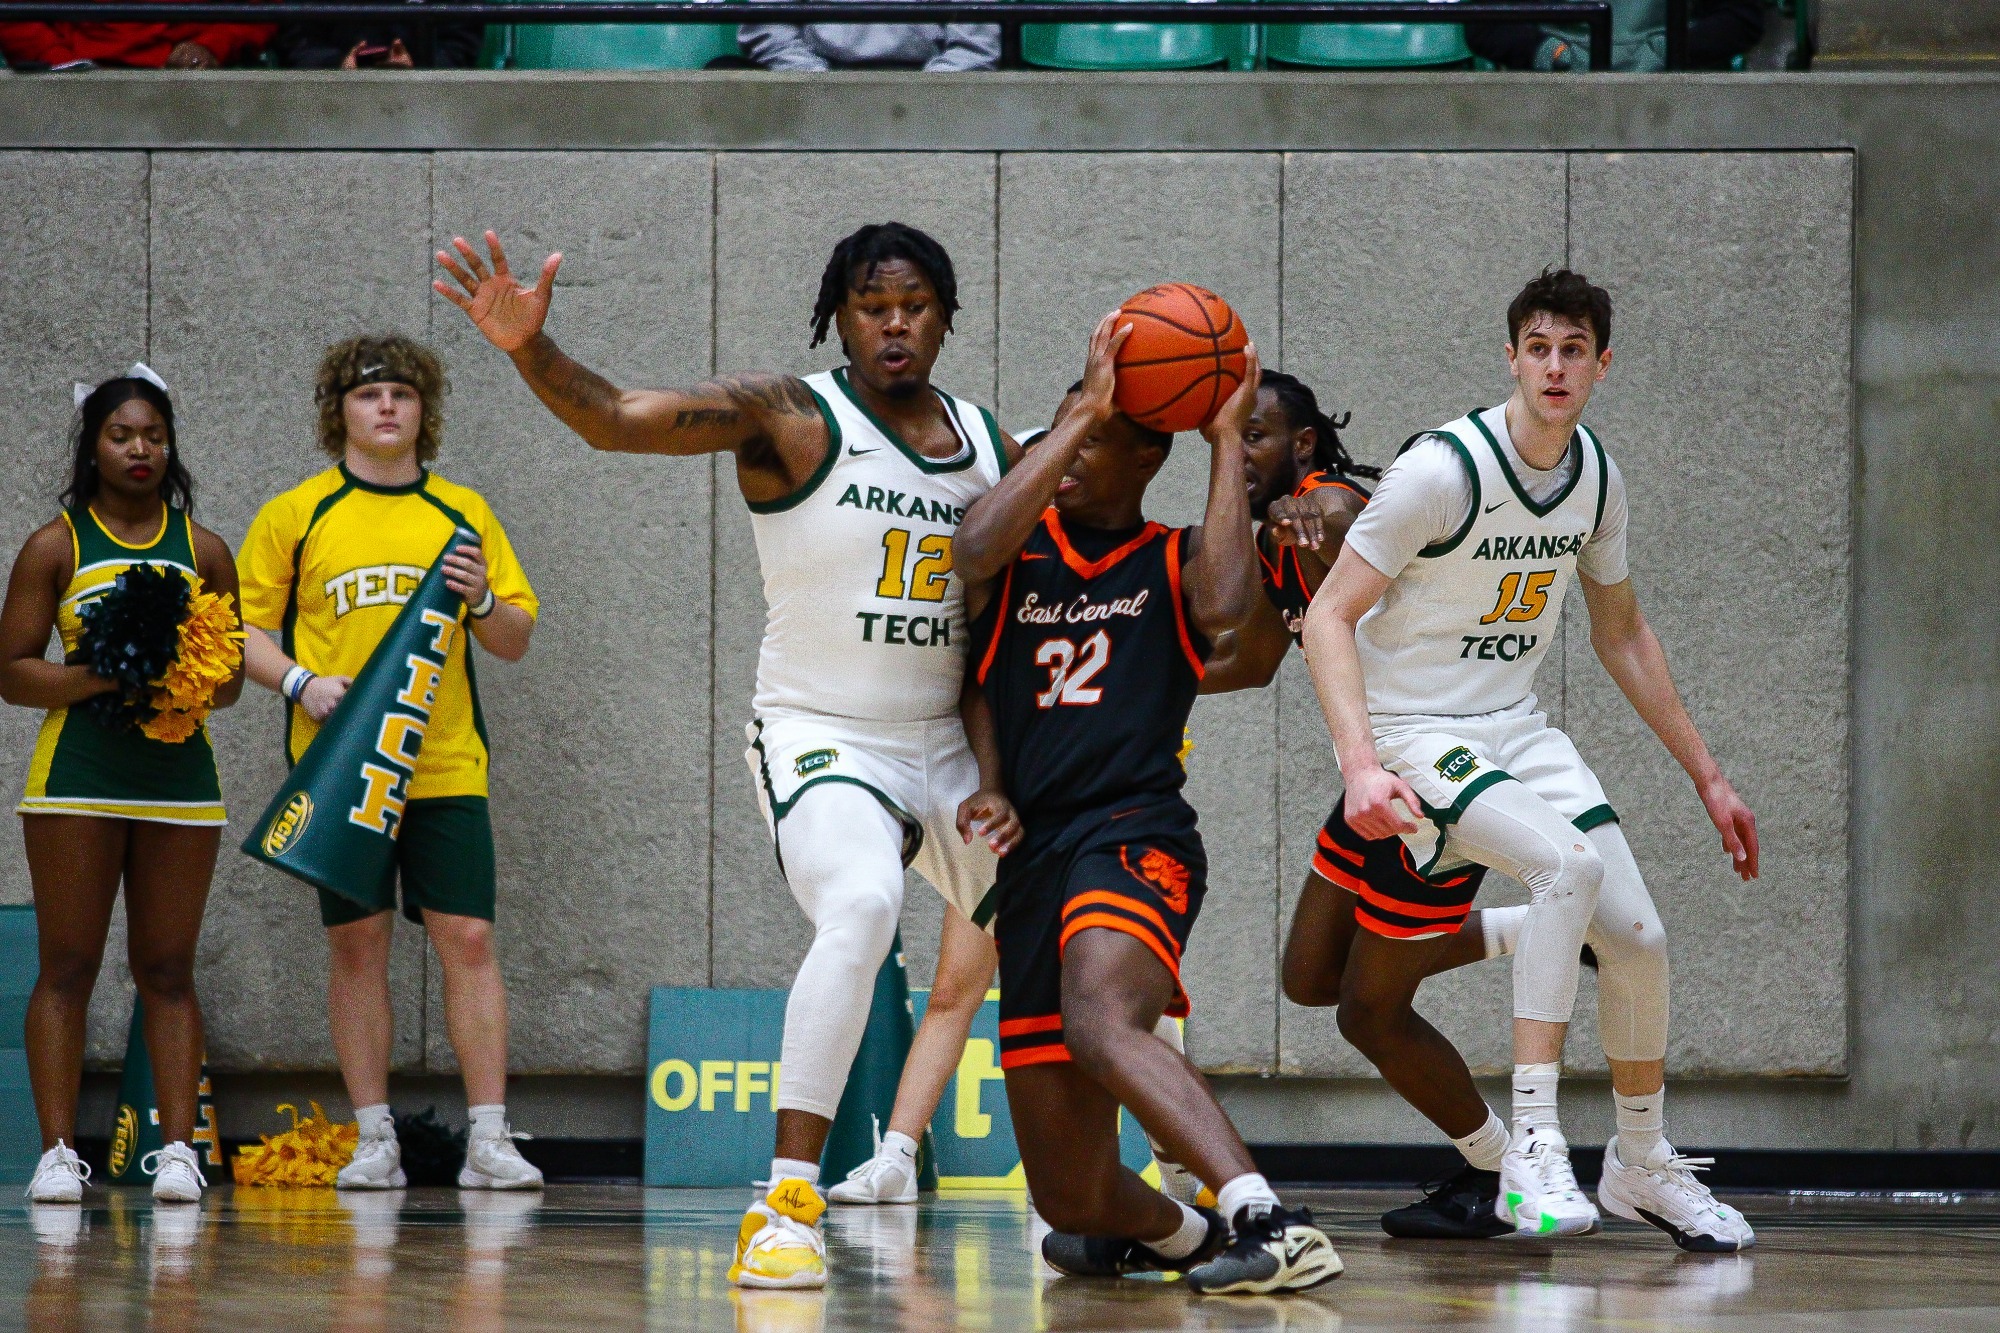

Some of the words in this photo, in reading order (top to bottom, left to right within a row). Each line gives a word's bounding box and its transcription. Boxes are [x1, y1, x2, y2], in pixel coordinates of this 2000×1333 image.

[324, 564, 429, 620] TEC
[875, 528, 954, 603] 12
[1017, 592, 1063, 623] East
[1479, 569, 1557, 625] 15
[856, 612, 951, 647] TECH
[1460, 633, 1537, 662] TECH
[1035, 629, 1112, 710] 32
[1441, 752, 1475, 777] TECH
[270, 795, 308, 850] TECH
